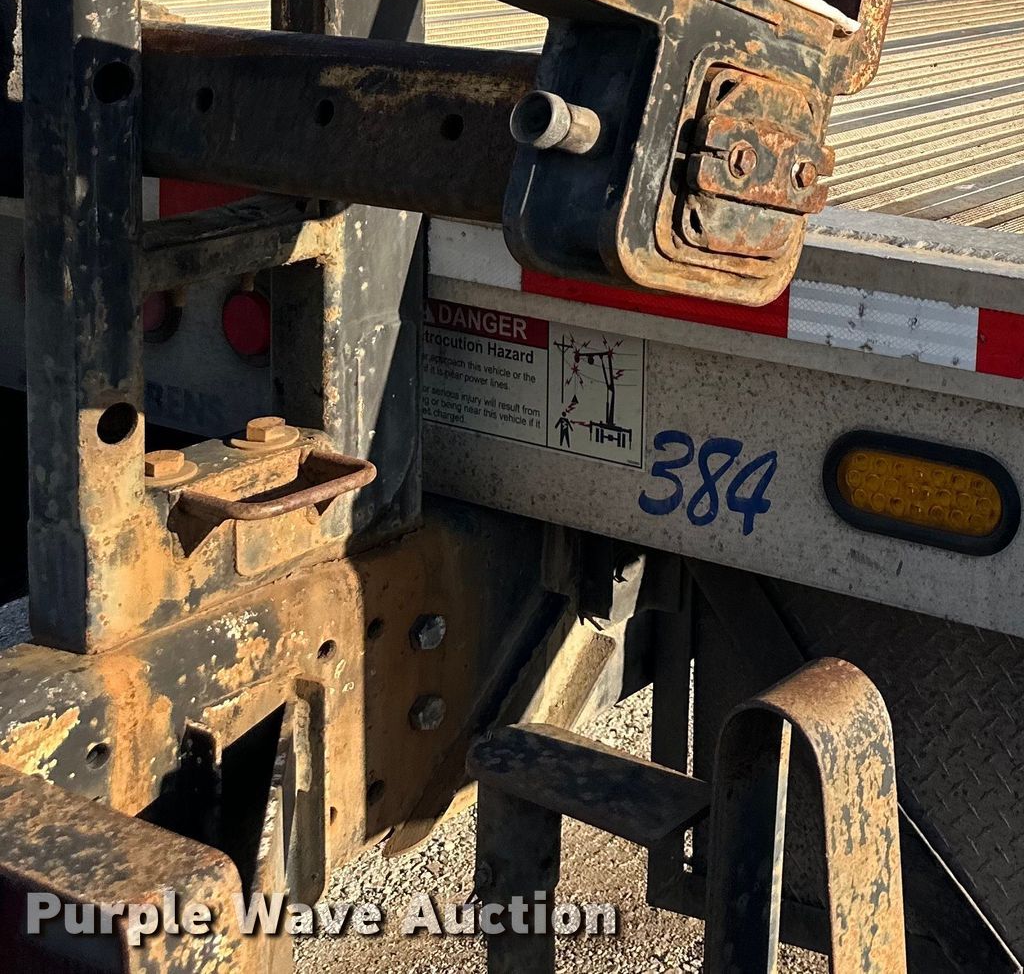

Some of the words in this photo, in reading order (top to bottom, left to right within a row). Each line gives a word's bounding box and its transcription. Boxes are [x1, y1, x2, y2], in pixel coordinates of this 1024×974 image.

[439, 304, 528, 340] DANGER
[423, 329, 483, 354] trocution
[487, 341, 534, 364] Hazard
[464, 374, 488, 386] power
[467, 360, 482, 372] this
[483, 365, 511, 378] vehicle
[512, 371, 522, 379] or
[523, 372, 536, 384] the
[440, 398, 462, 414] being
[463, 405, 482, 415] near
[483, 408, 497, 420] this
[499, 413, 527, 426] vehicle
[461, 394, 481, 406] injury
[483, 396, 497, 408] will
[498, 401, 520, 413] result
[522, 405, 541, 417] from
[637, 429, 778, 536] 384
